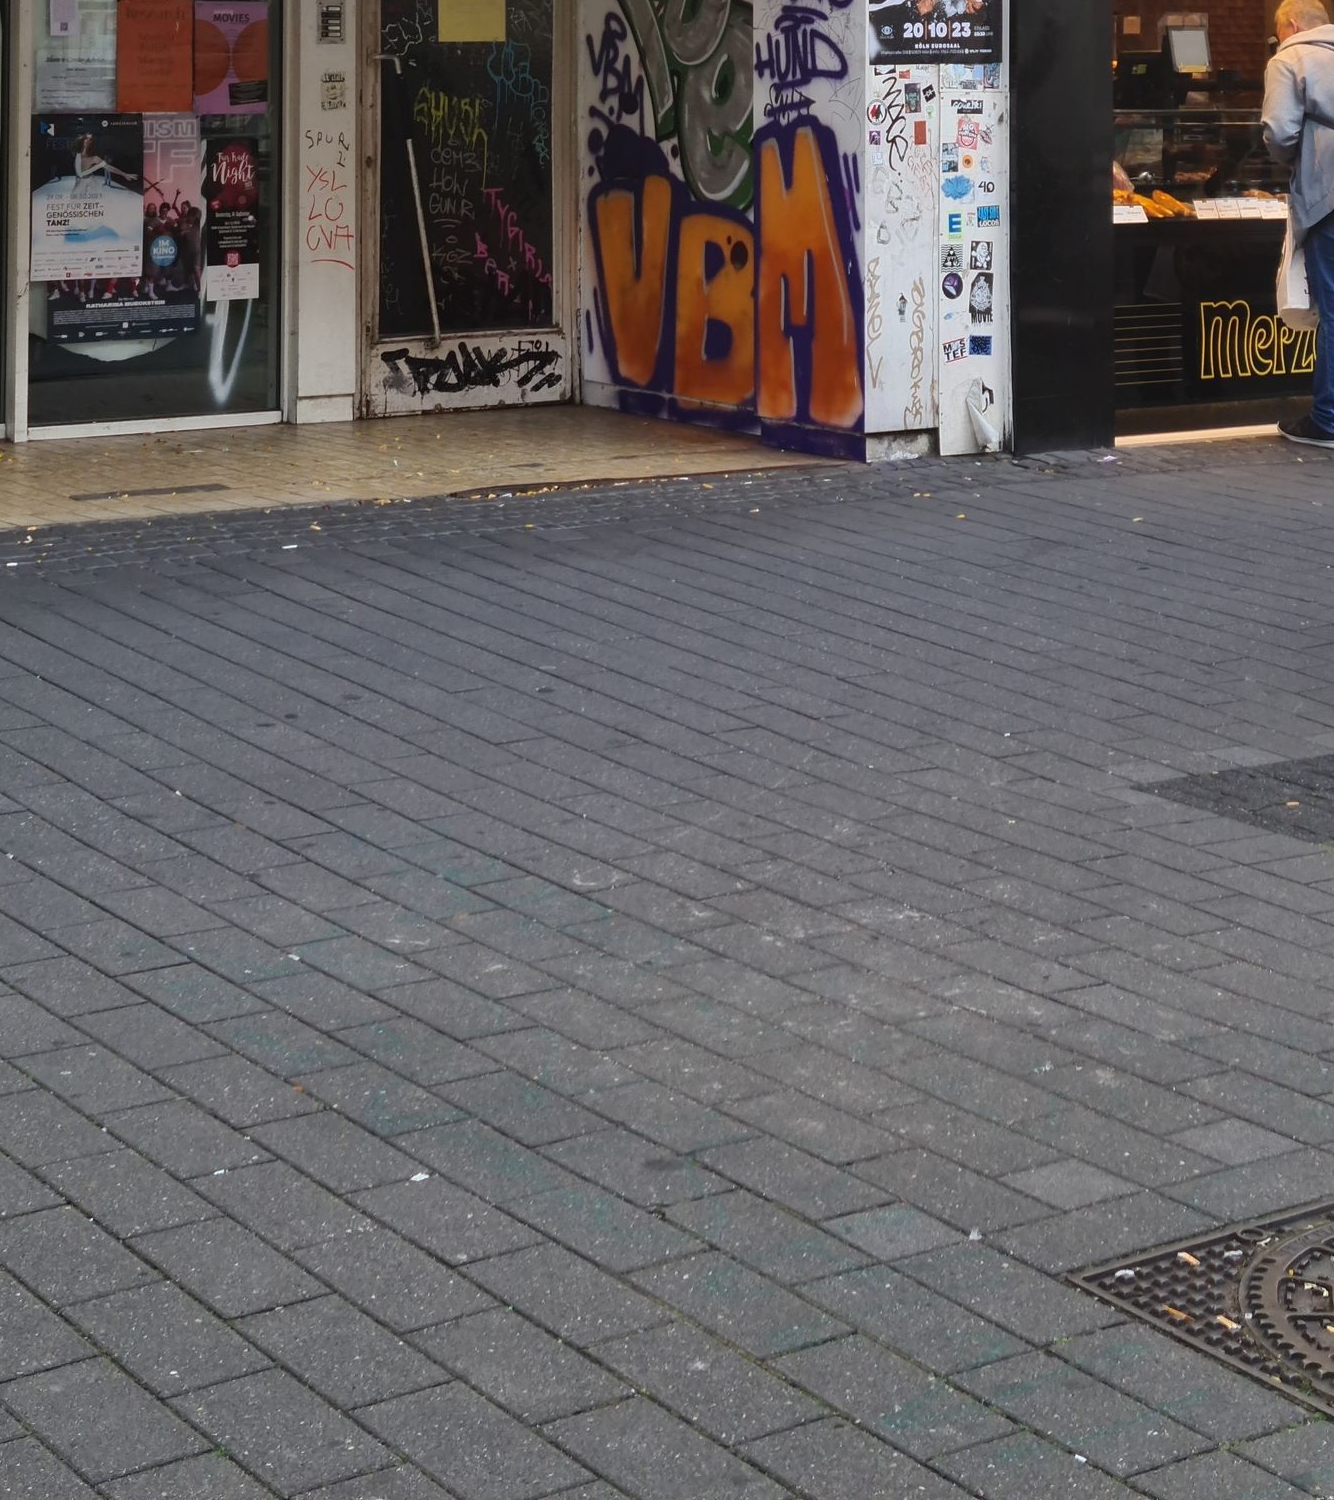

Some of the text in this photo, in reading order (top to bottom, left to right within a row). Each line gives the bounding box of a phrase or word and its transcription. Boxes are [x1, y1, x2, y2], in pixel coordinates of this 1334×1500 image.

[213, 12, 251, 23] MOVIES
[903, 21, 972, 38] 20 10 23
[211, 161, 256, 186] Night
[46, 219, 70, 227] TANZ!
[152, 245, 176, 256] KINO
